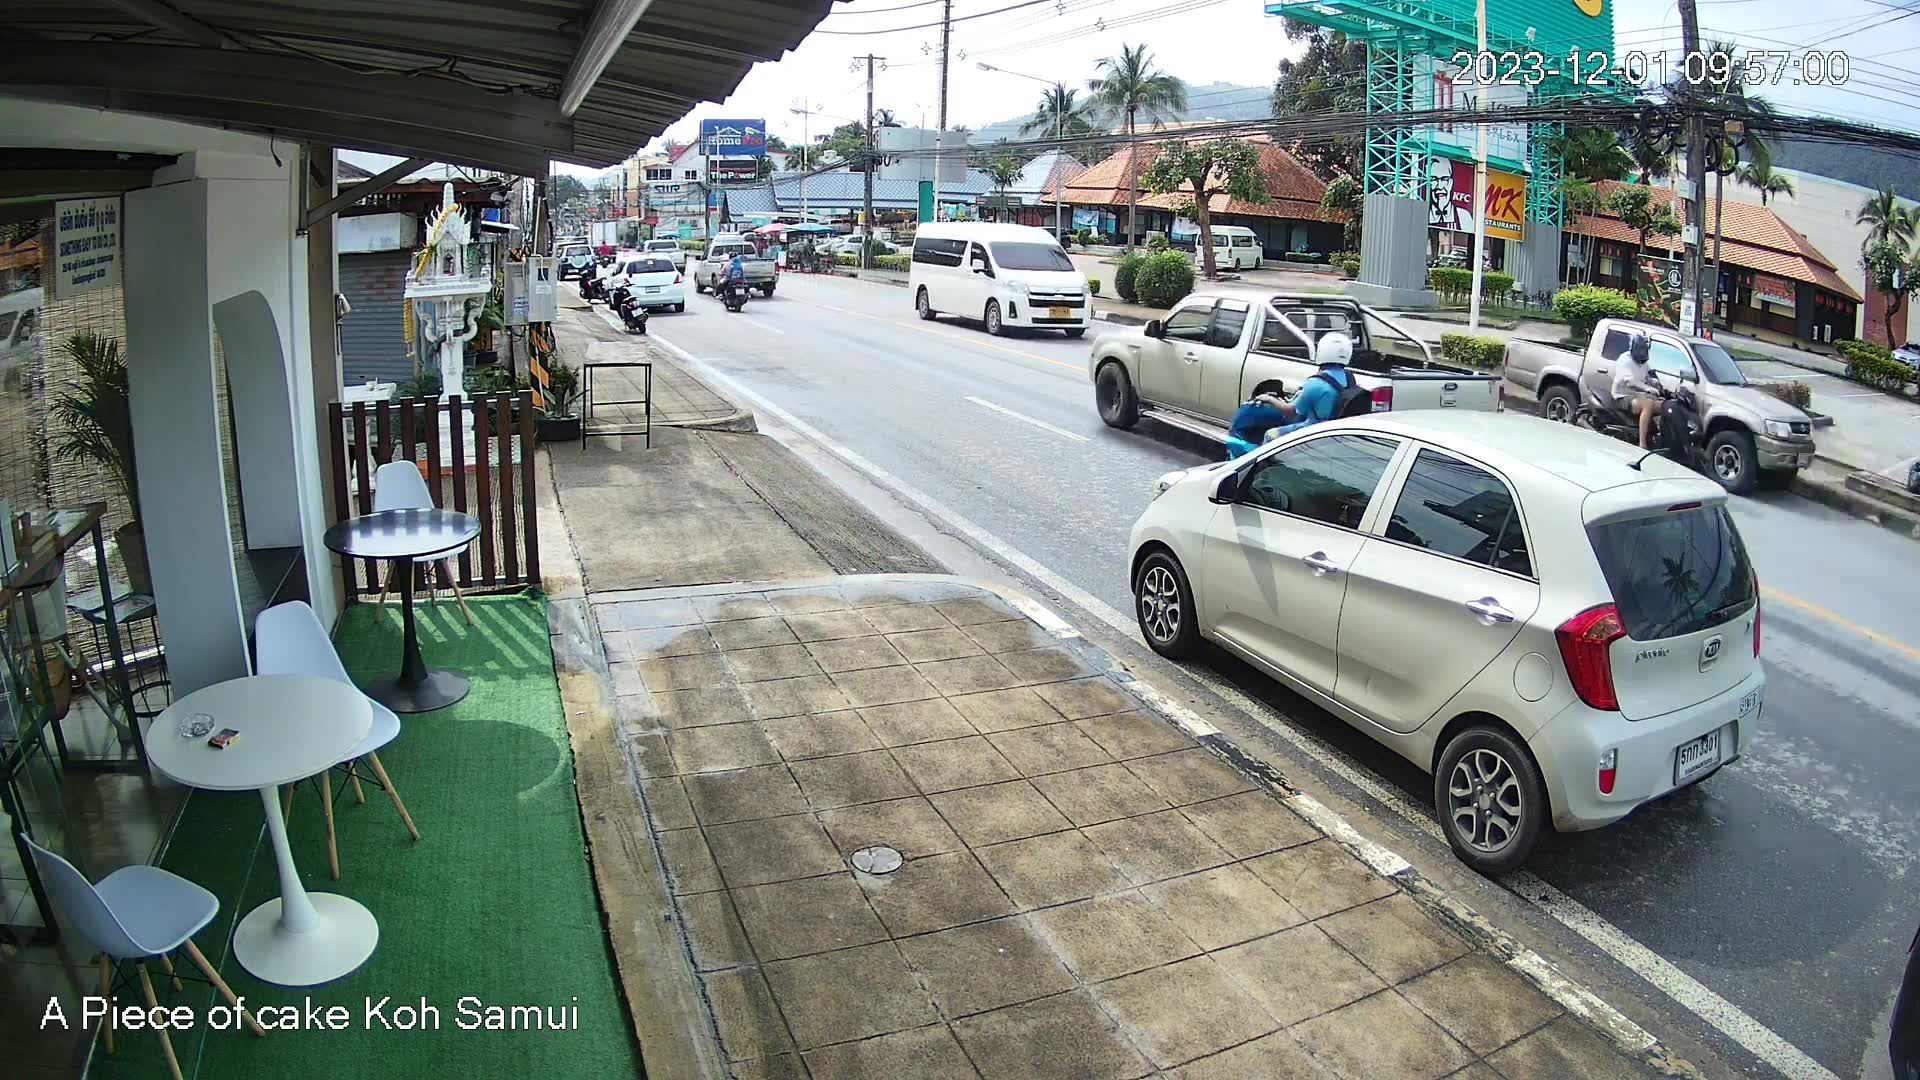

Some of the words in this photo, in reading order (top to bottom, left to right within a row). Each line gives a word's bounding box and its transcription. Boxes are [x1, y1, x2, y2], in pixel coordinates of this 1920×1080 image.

[1452, 191, 1471, 203] KFC
[1484, 183, 1523, 222] MK
[1484, 218, 1521, 231] STAURANTS
